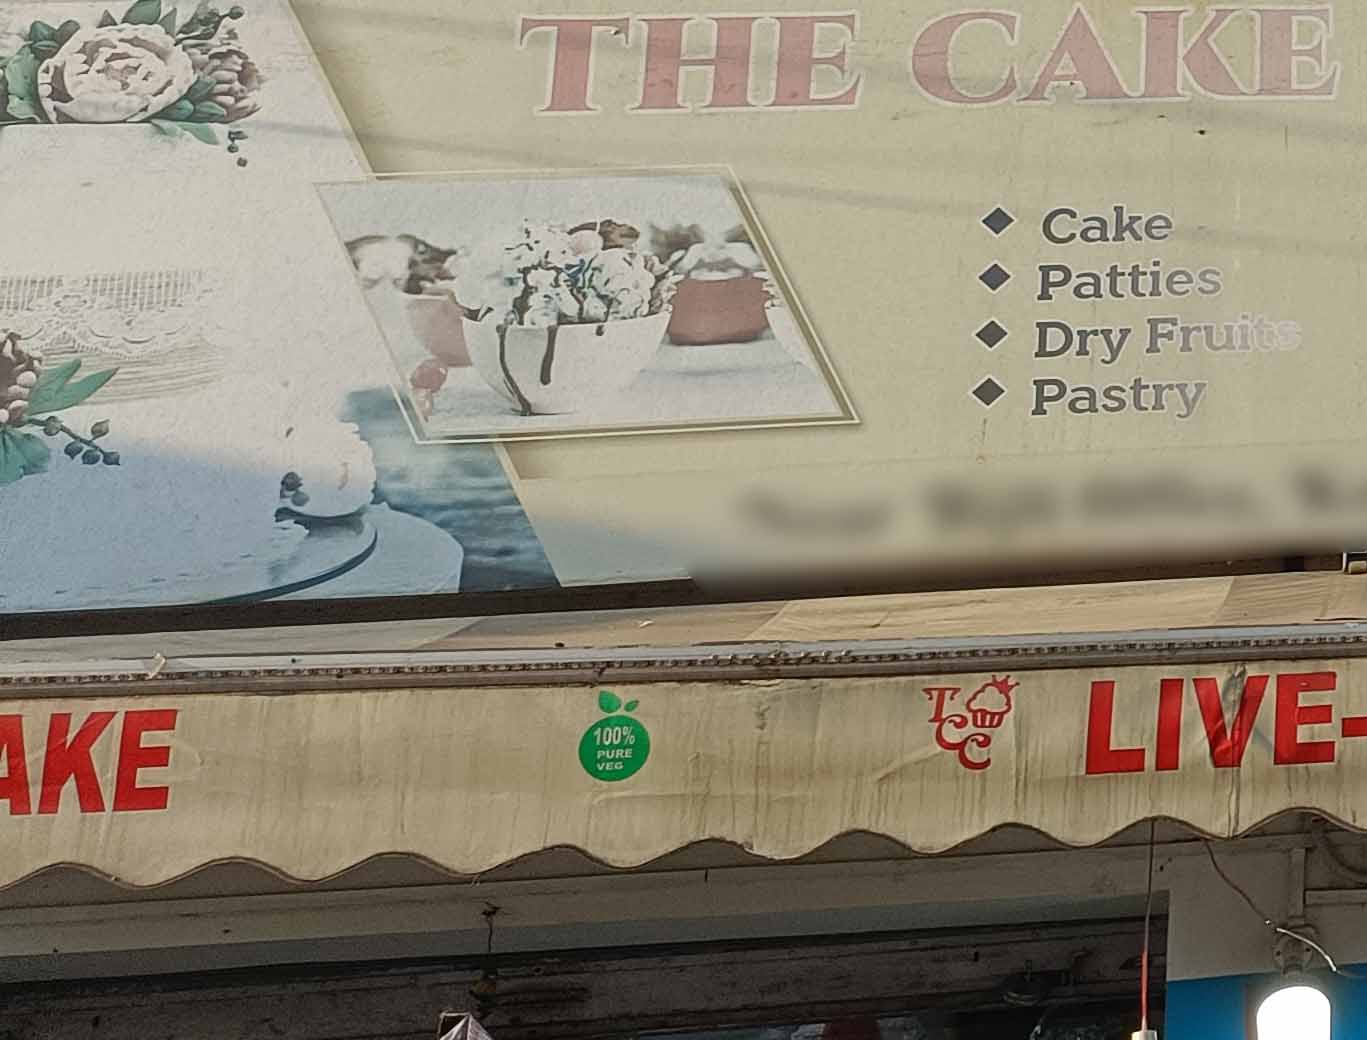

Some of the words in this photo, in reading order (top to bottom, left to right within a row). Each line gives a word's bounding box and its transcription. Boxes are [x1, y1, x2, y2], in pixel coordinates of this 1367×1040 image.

[519, 9, 862, 116] THE
[910, 3, 1342, 107] CAKE
[1041, 205, 1174, 246] Cake
[1034, 260, 1223, 303] Patties
[1033, 320, 1132, 366] Dry
[1144, 314, 1302, 356] Fruits
[1031, 374, 1208, 420] Pastry
[593, 726, 636, 746] 100%
[596, 748, 633, 760] PURE
[596, 761, 624, 771] VEG
